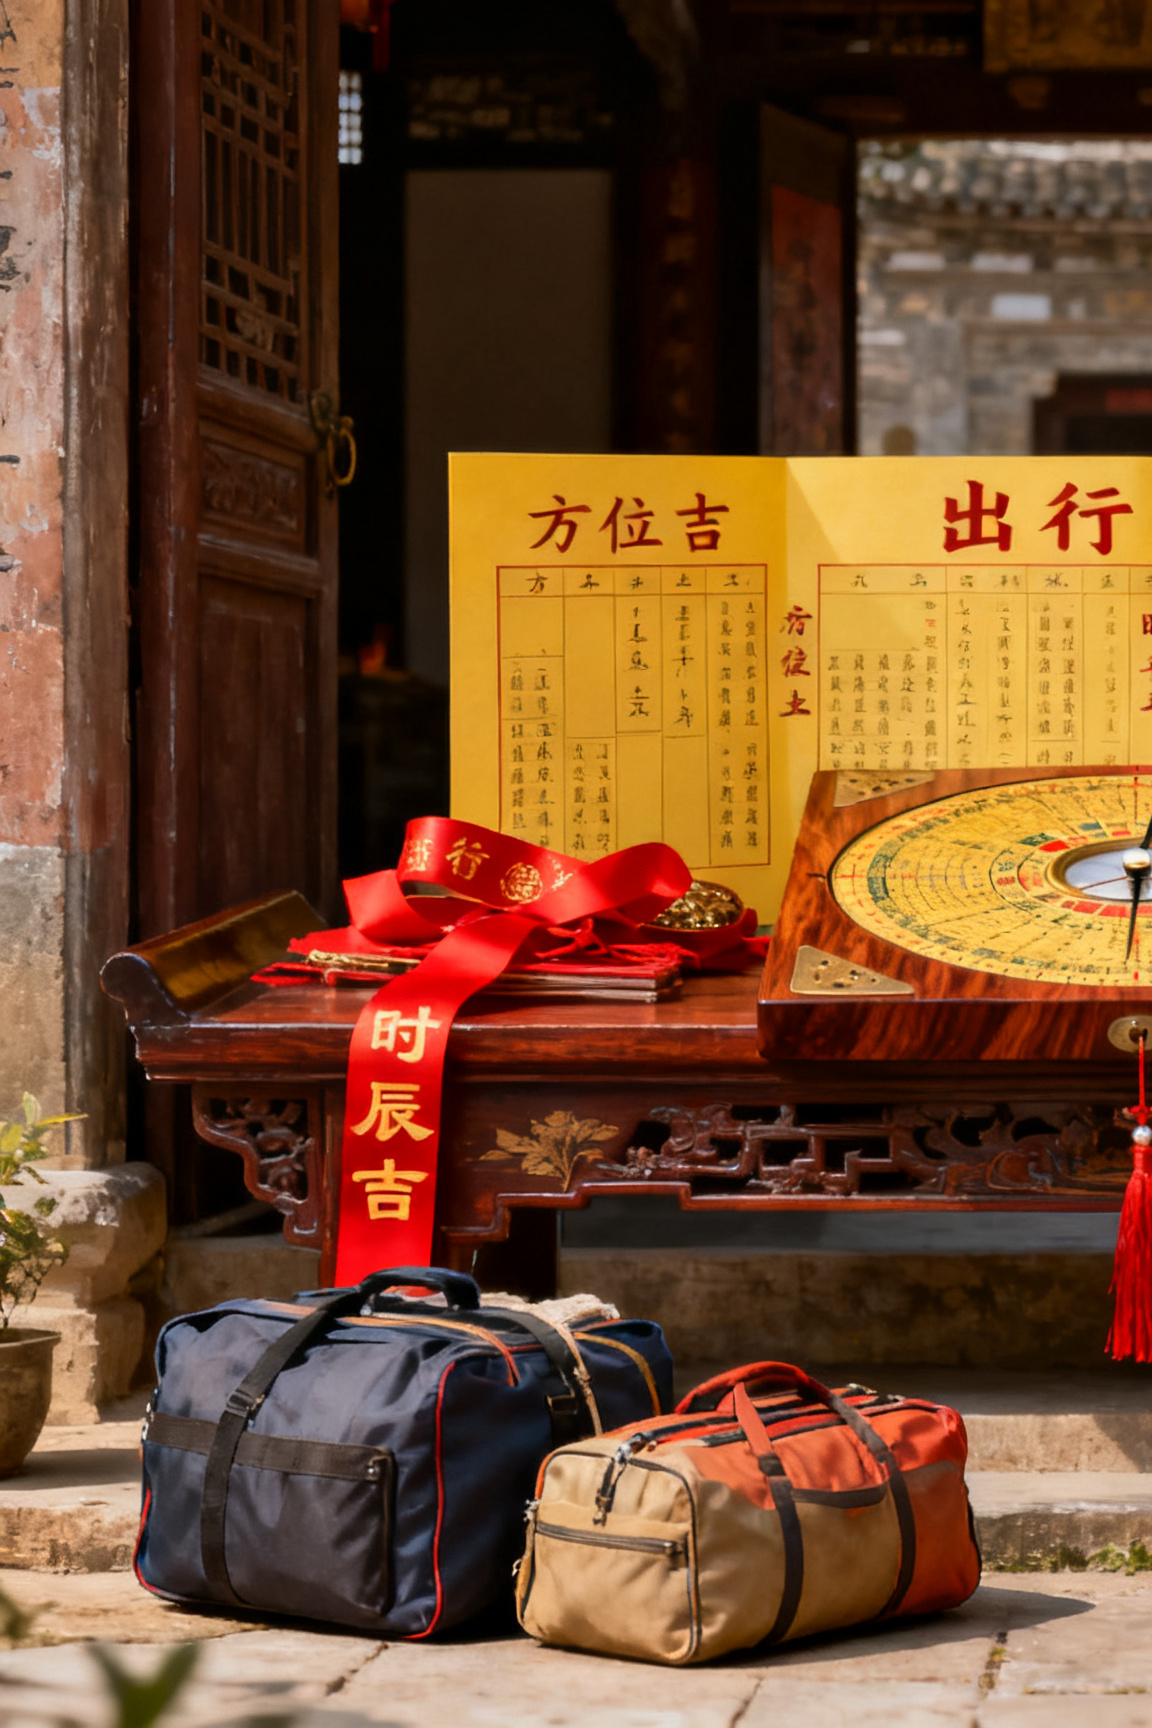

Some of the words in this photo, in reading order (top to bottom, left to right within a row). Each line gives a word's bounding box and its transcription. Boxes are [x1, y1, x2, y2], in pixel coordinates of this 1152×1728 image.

[528, 492, 731, 556] 方位吉
[944, 480, 1135, 557] 出行
[350, 1006, 442, 1221] 时辰吉
